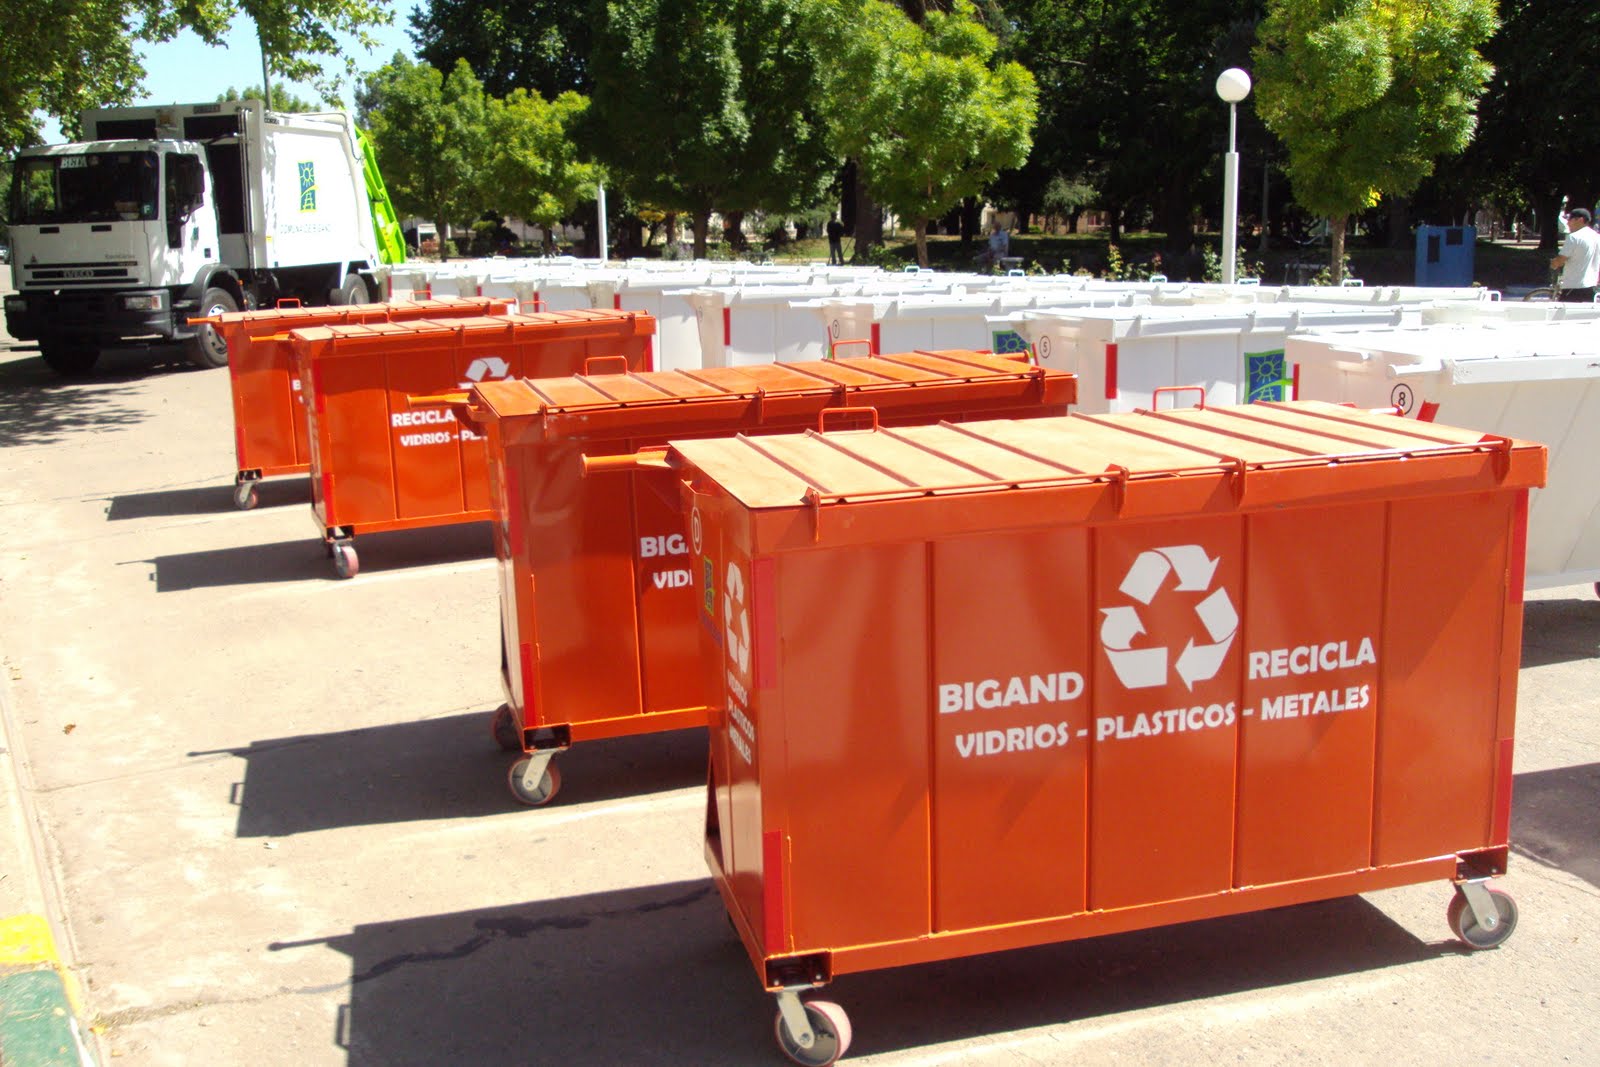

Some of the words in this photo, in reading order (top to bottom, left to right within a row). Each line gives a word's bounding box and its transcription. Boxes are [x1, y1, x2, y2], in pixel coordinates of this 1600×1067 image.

[1397, 391, 1406, 407] 8
[391, 409, 455, 427] RECICLA
[400, 431, 450, 446] VIDRIOS
[640, 533, 689, 558] BIG
[938, 671, 1084, 714] BIGAND
[1248, 637, 1377, 680] RECICLA
[954, 721, 1069, 758] VIDRIOS
[1095, 701, 1236, 741] PLASTICOS
[1260, 684, 1370, 720] METALES
